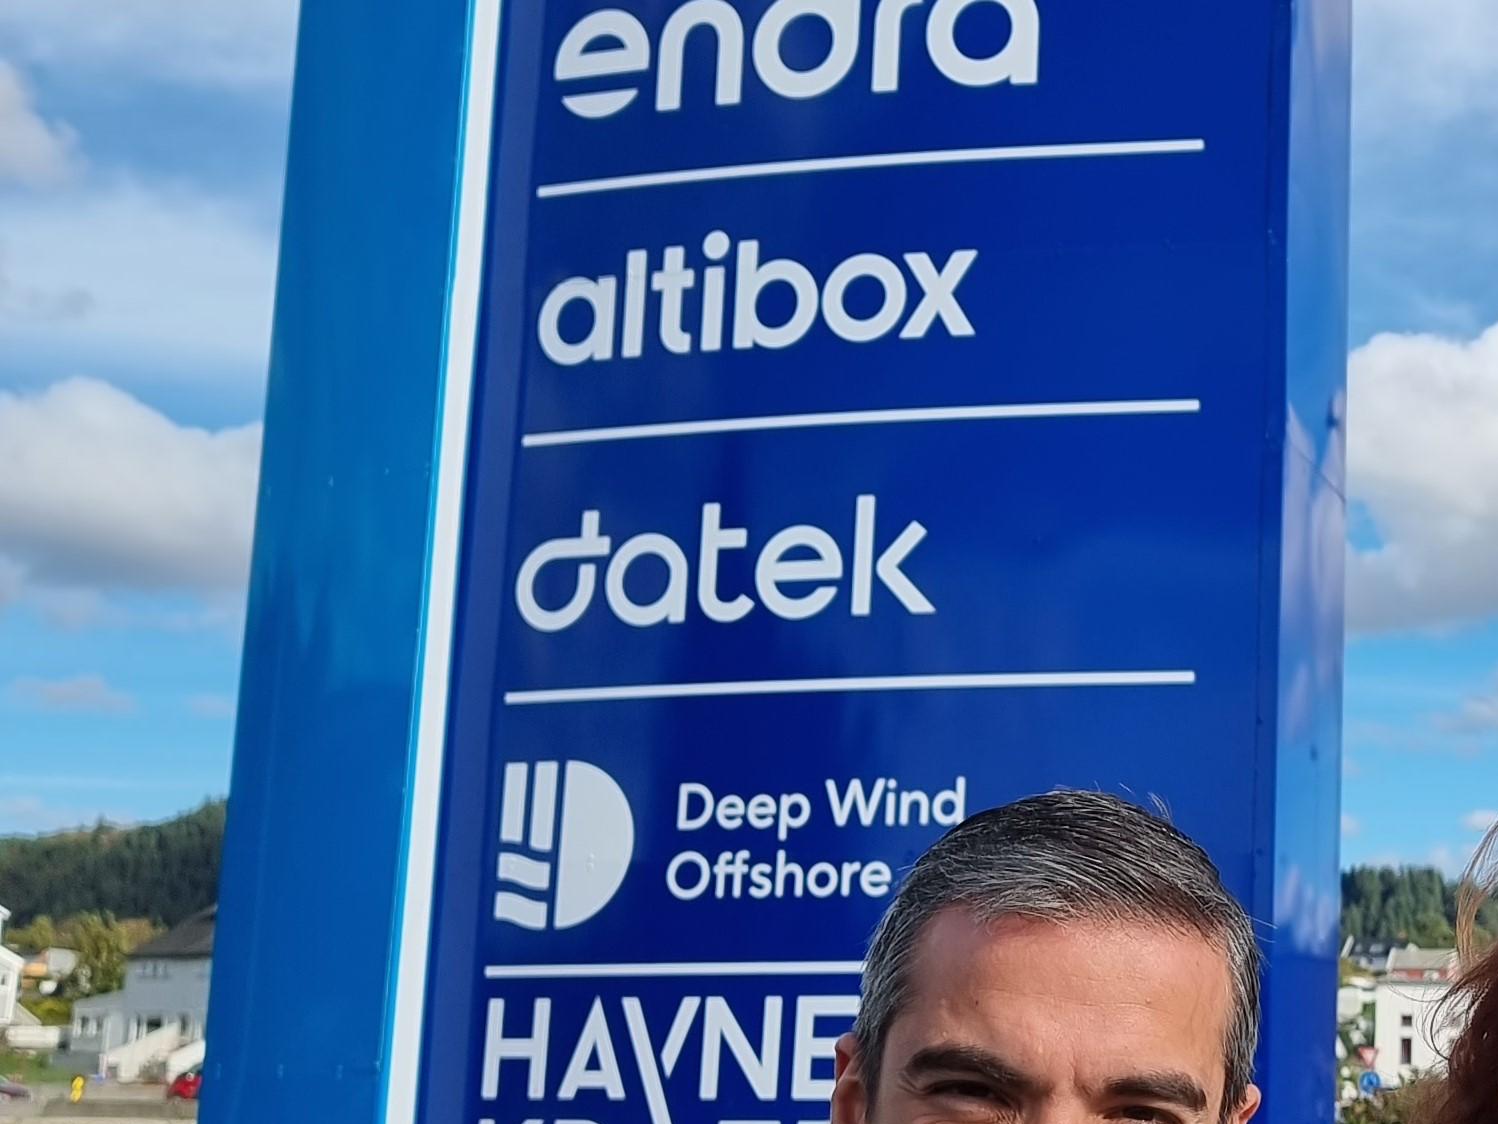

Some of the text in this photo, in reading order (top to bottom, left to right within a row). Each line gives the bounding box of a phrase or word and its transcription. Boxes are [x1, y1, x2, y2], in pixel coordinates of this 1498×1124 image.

[554, 0, 1040, 118] endra
[538, 231, 978, 365] altibox
[516, 494, 936, 632] datek
[677, 776, 966, 841] Deep Wind
[666, 849, 893, 900] Offshore
[481, 995, 862, 1101] HAVNE
